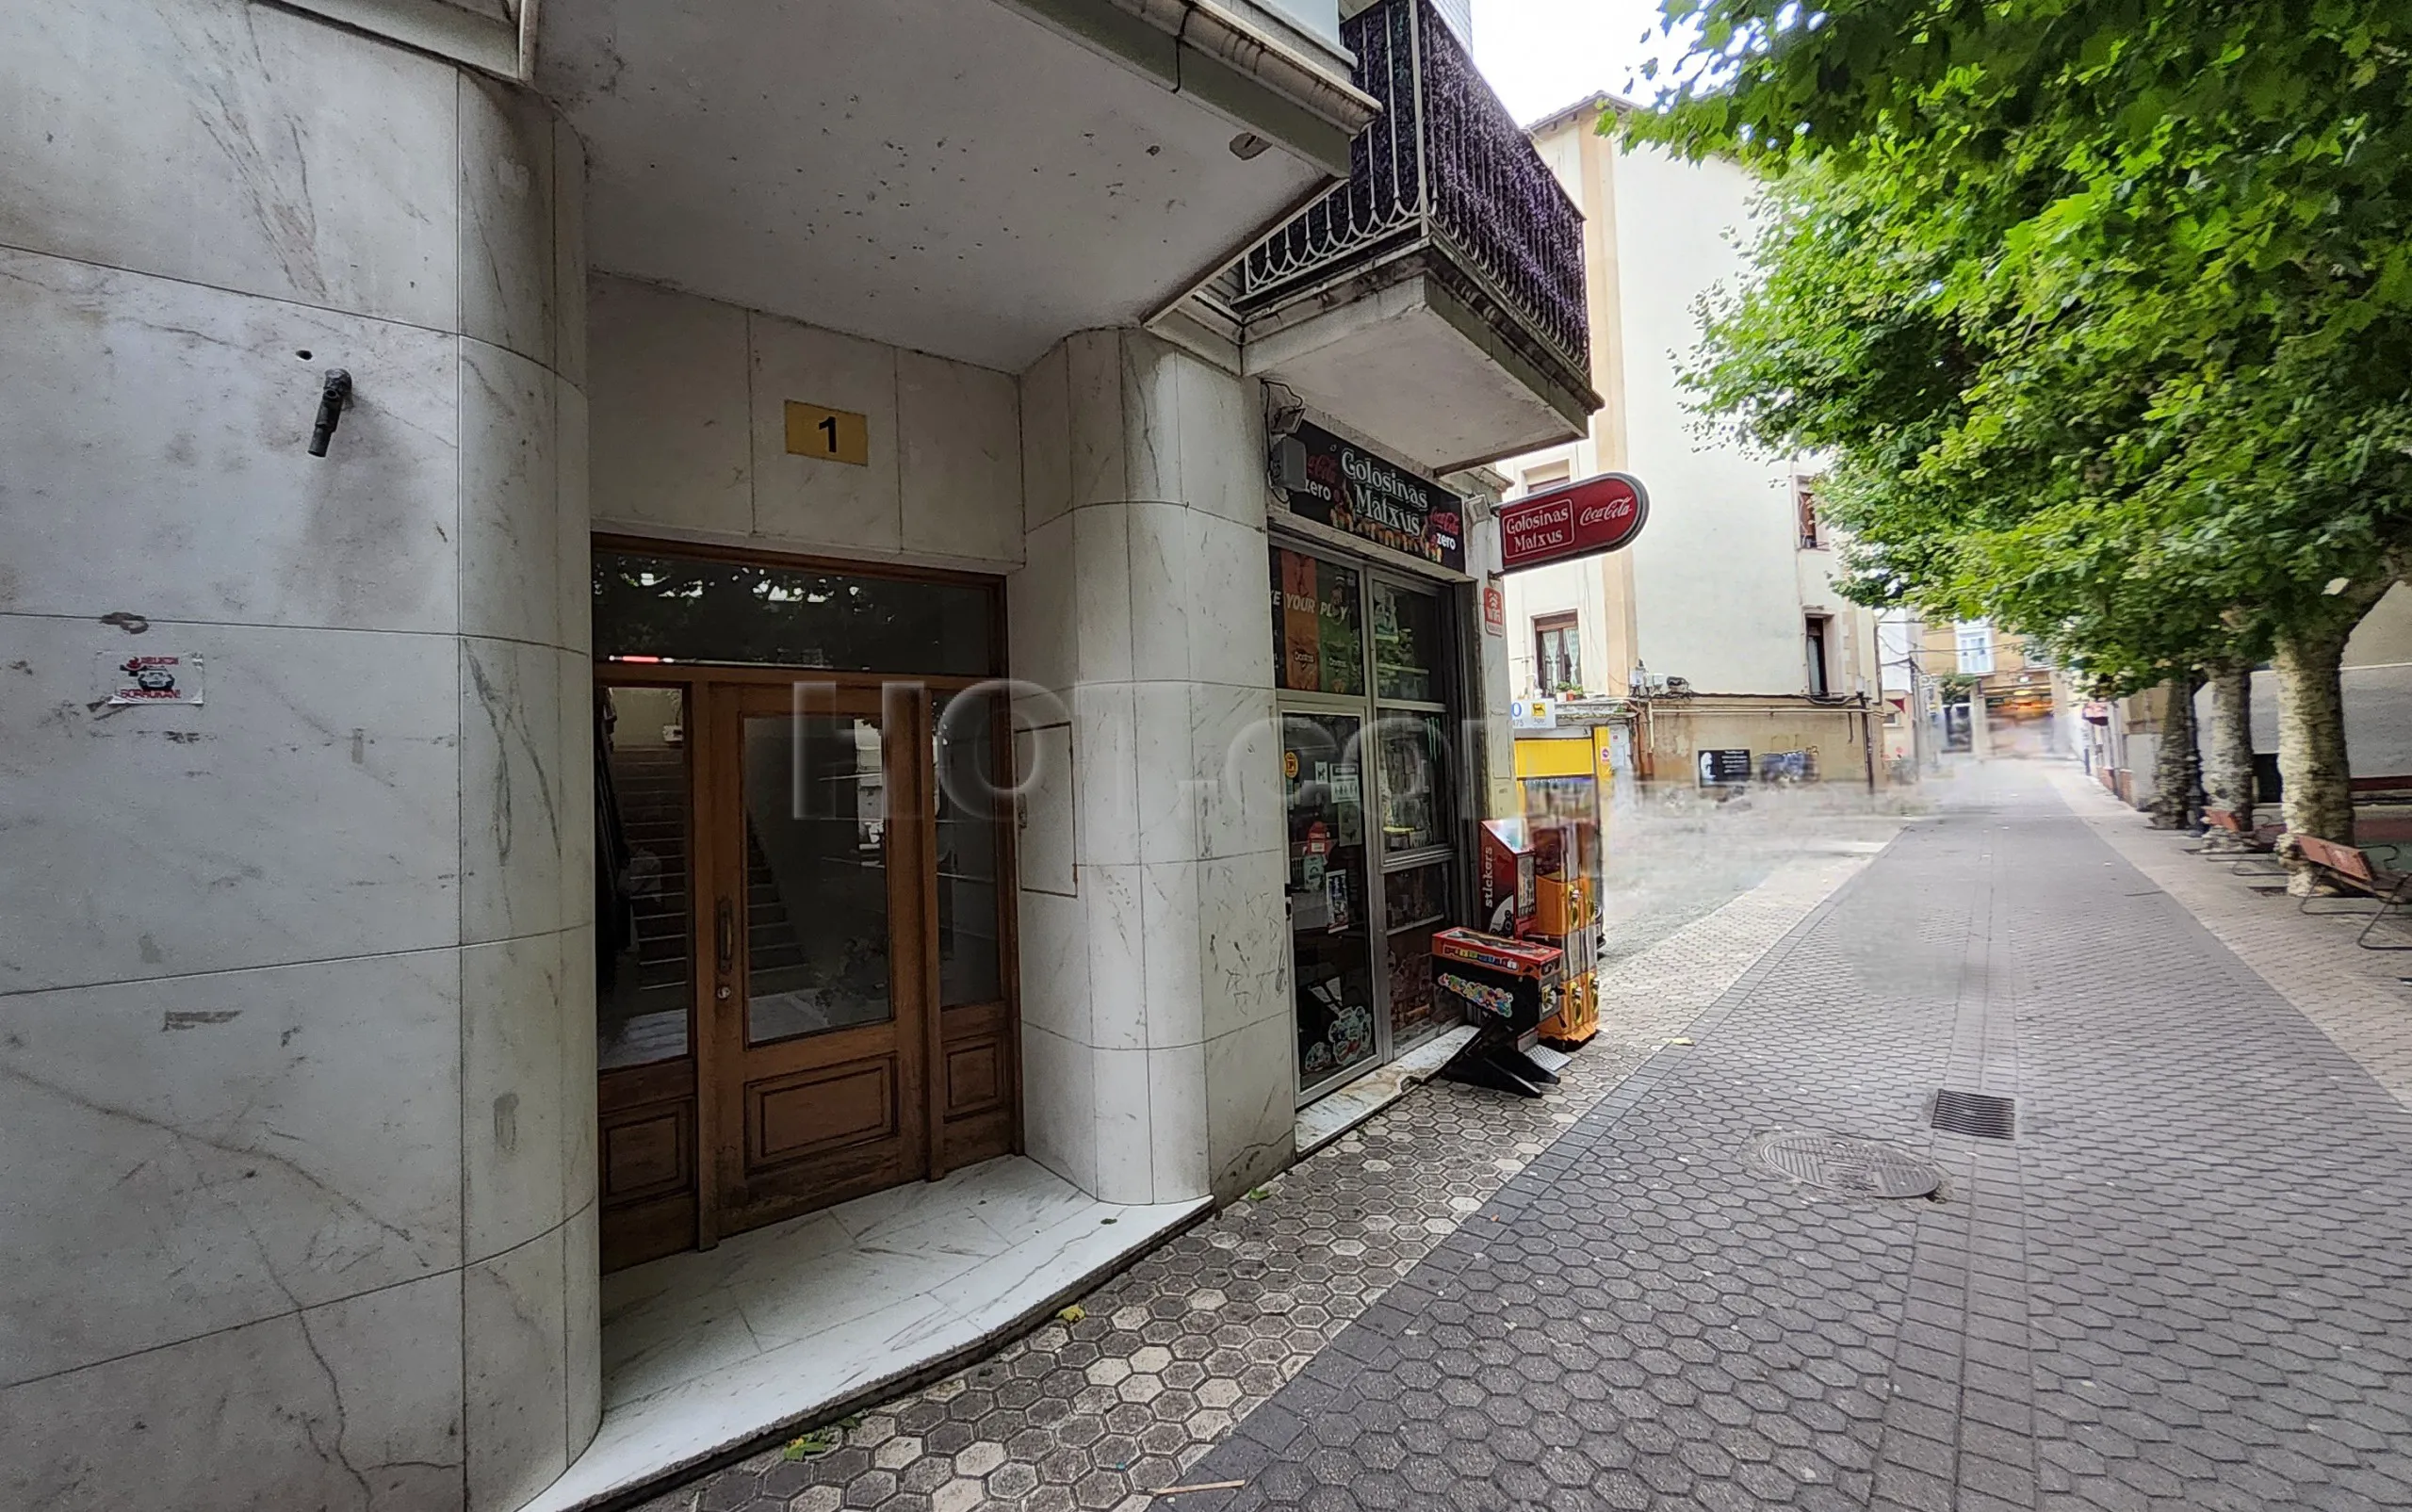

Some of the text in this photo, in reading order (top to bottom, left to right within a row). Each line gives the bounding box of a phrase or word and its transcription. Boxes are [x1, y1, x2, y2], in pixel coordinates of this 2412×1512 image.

[818, 415, 838, 453] 1
[1342, 448, 1428, 510] Golosinas
[1354, 484, 1421, 537] Matxus
[1507, 507, 1569, 535] Golosinas
[1437, 532, 1457, 550] zero
[1513, 528, 1564, 553] Matxus
[1285, 593, 1315, 614] YOUR
[1319, 601, 1348, 622] PLY
[1482, 846, 1493, 908] stickers
